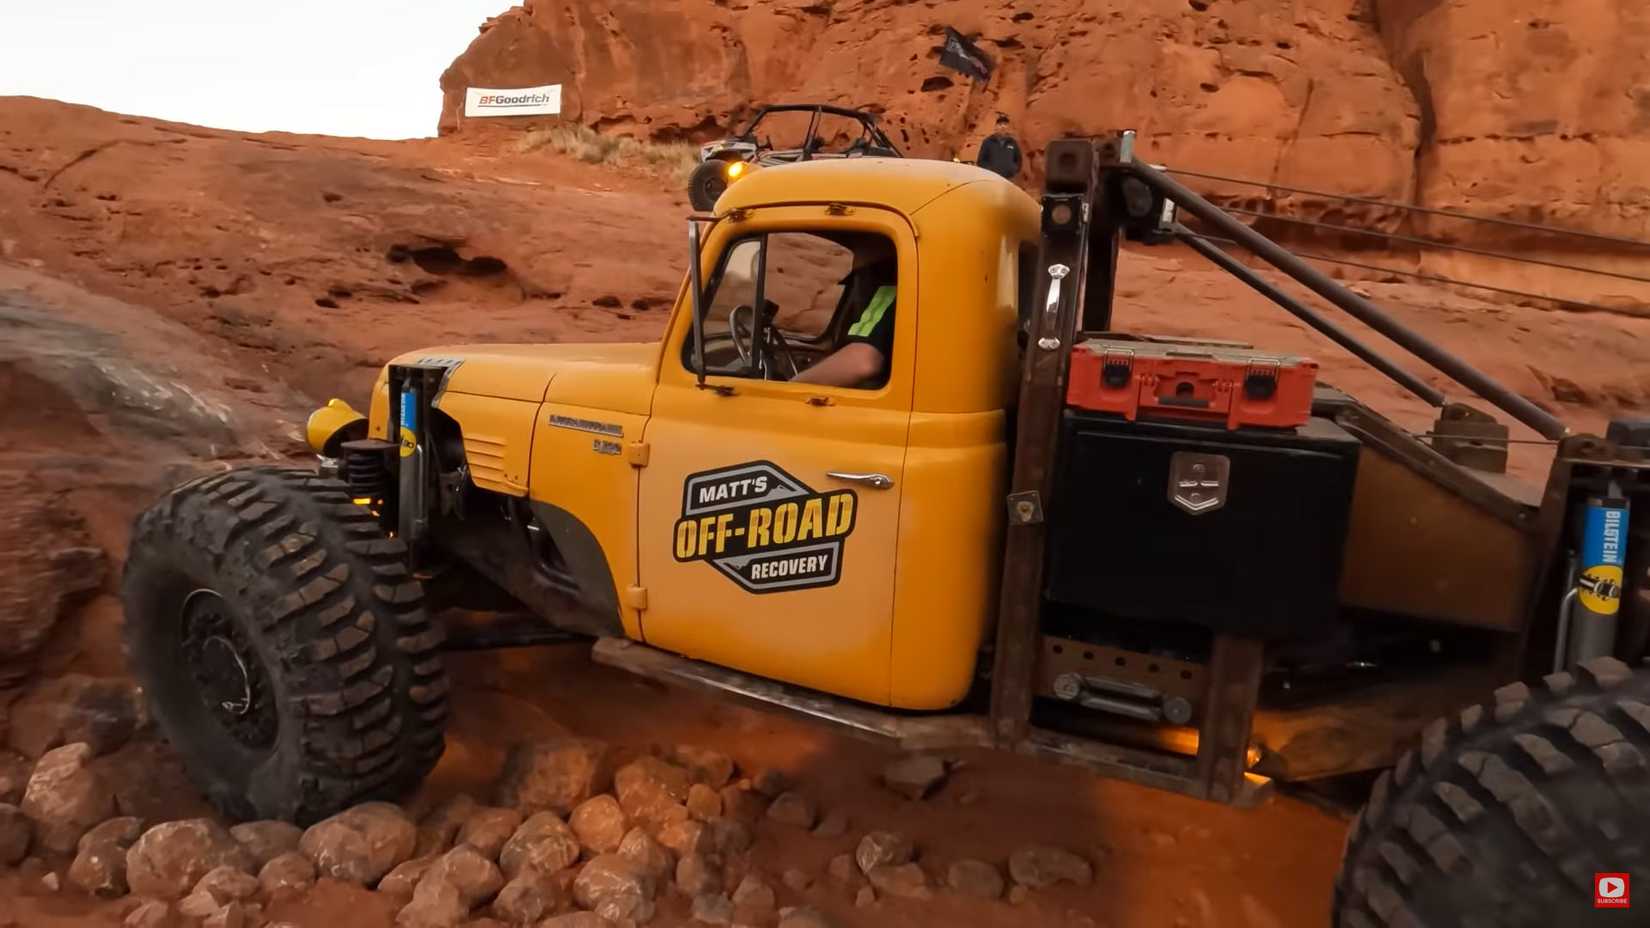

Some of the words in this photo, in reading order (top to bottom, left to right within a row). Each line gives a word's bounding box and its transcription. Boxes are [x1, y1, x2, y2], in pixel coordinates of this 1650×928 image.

[478, 94, 550, 104] BFGoodrich
[699, 476, 768, 503] MATT'S
[676, 493, 854, 559] OFF-ROAD
[751, 554, 828, 580] RECOVERY
